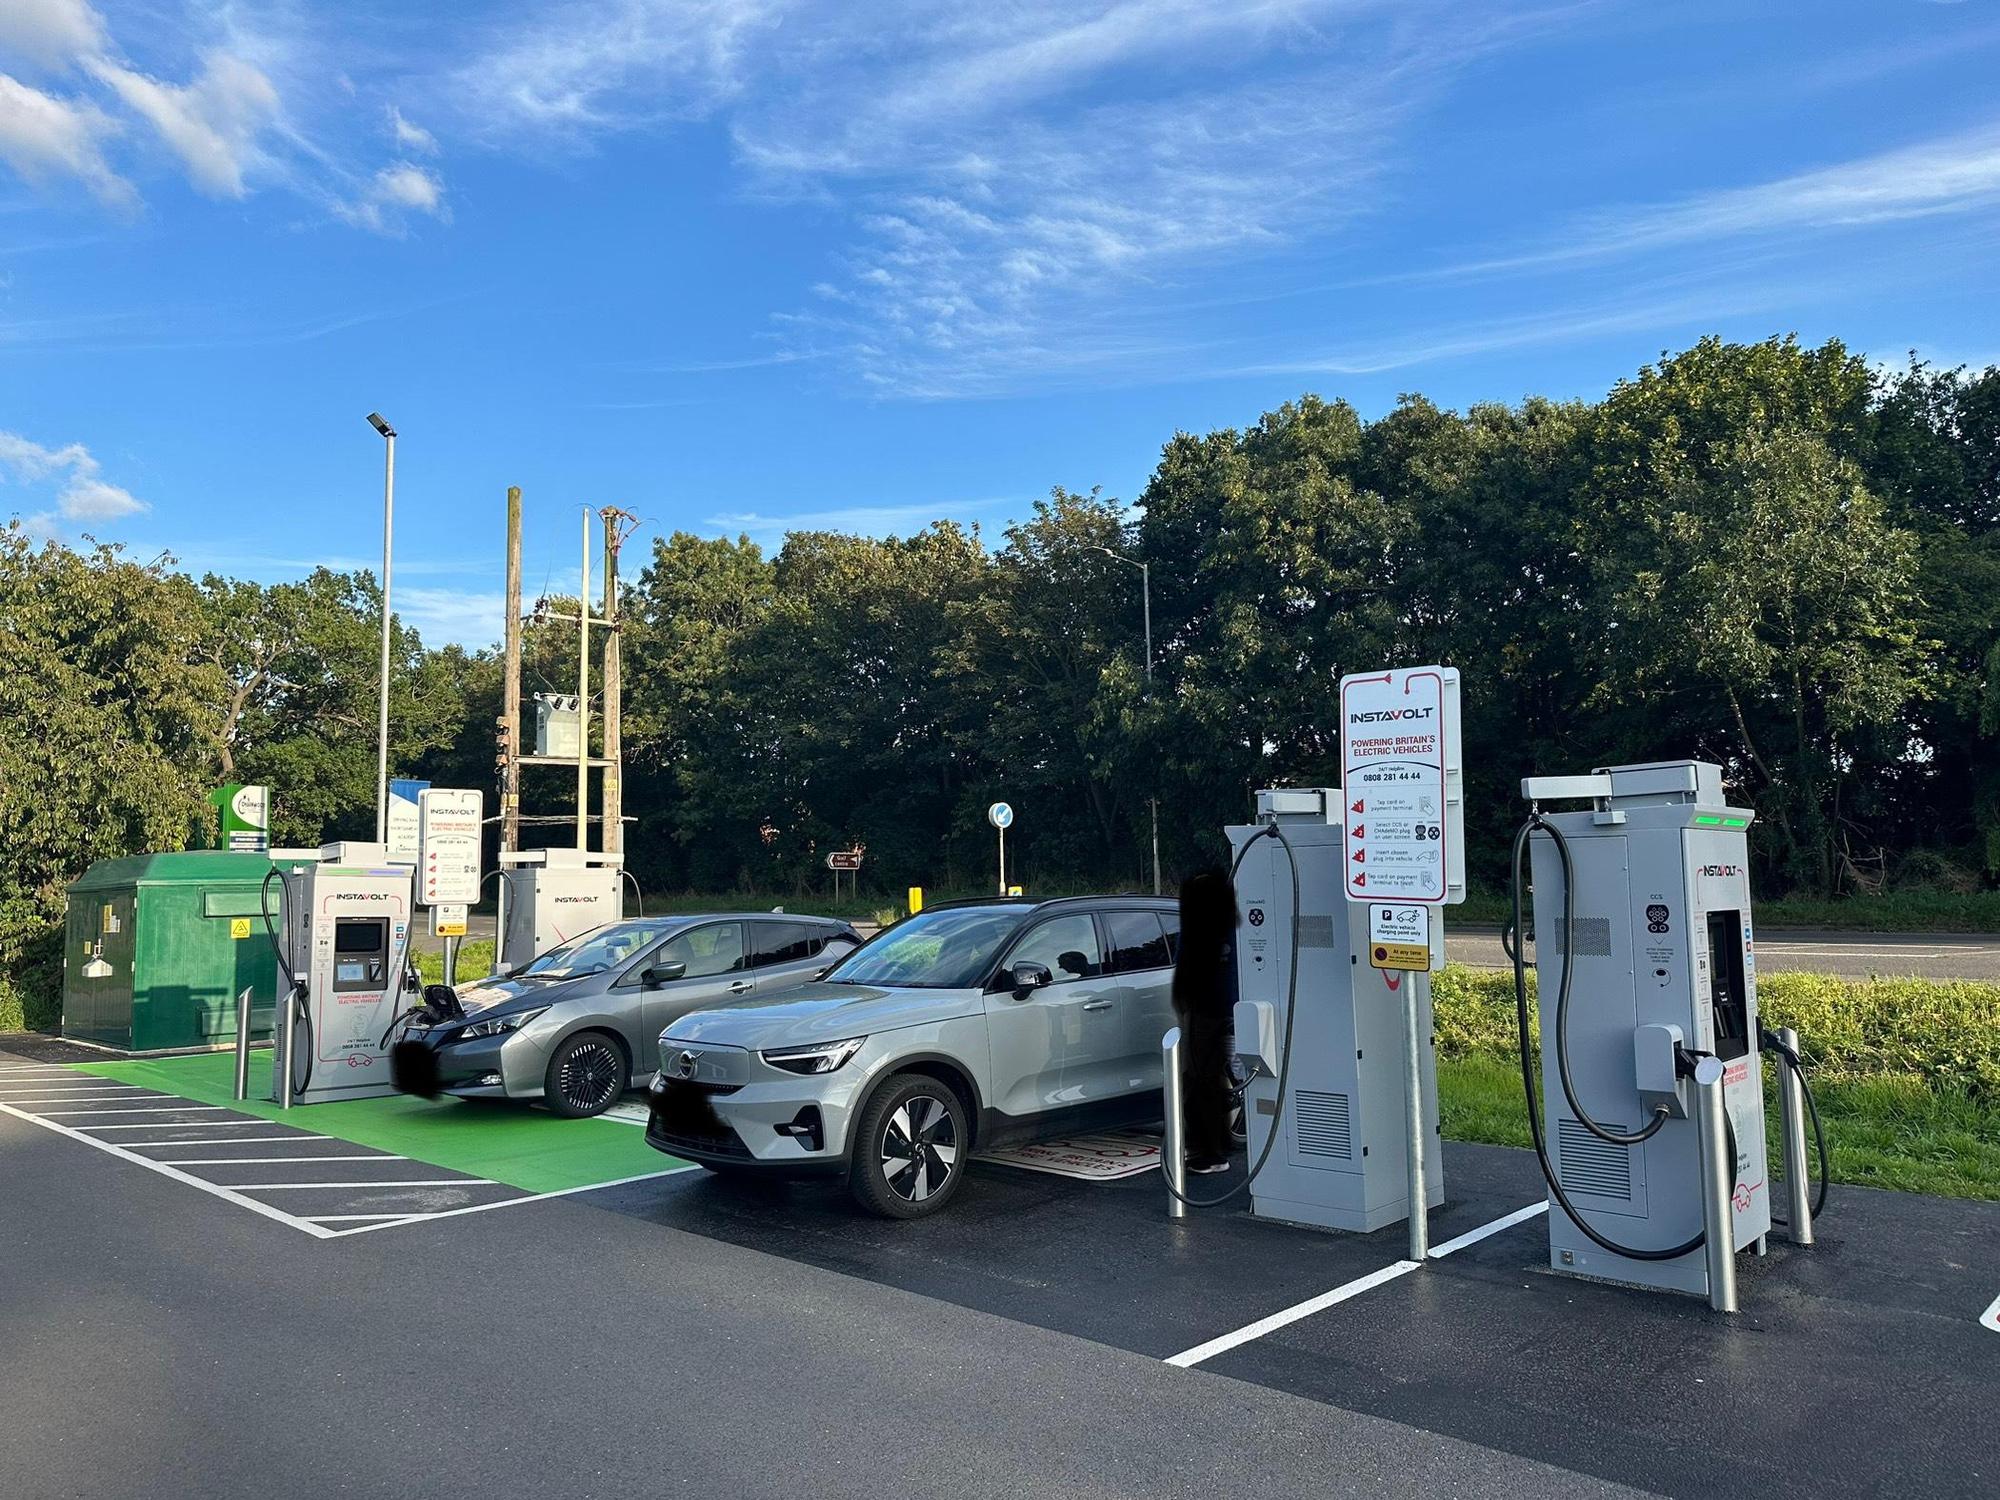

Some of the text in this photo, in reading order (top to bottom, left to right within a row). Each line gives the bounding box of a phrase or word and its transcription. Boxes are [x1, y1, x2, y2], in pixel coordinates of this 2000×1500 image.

[1350, 707, 1434, 724] INSTAVOLT
[1352, 735, 1436, 748] POWERING BRITAIN'S
[1354, 745, 1433, 757] ELECTRIC VEHICLES
[1704, 865, 1736, 876] INSTAVOLT
